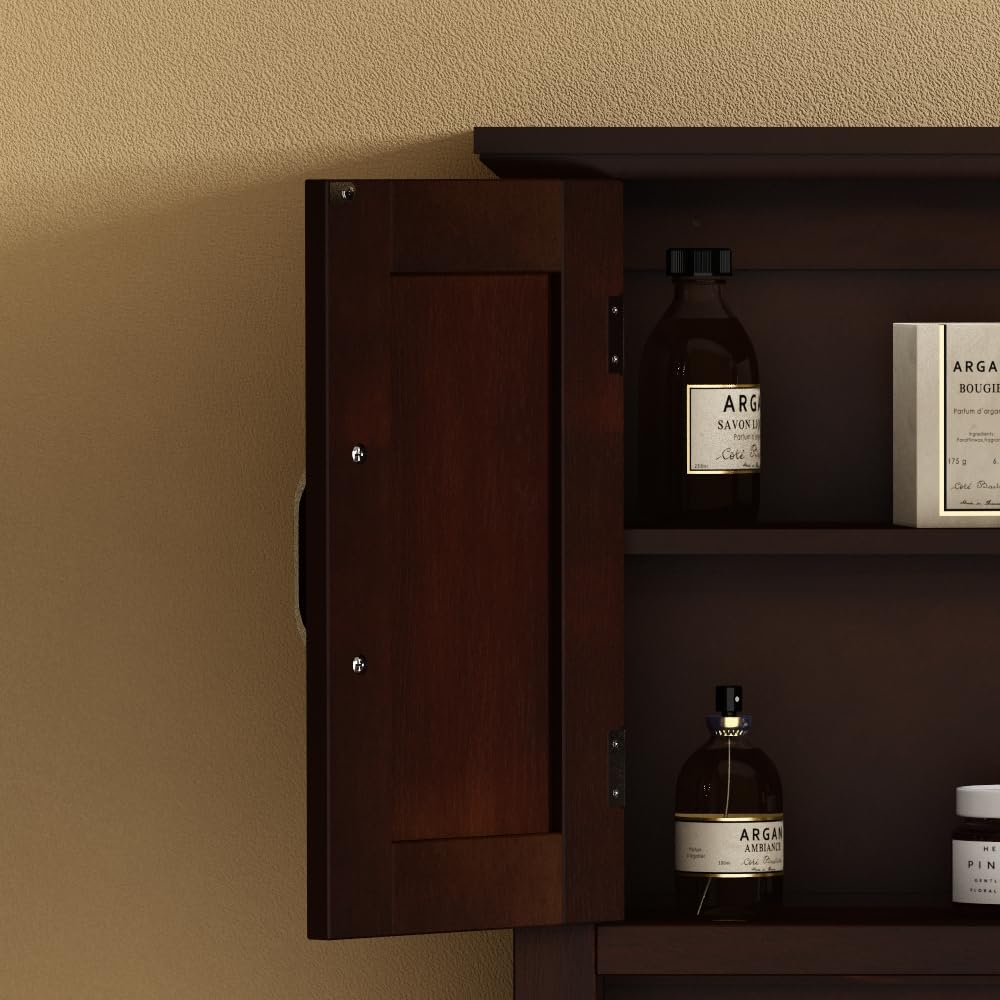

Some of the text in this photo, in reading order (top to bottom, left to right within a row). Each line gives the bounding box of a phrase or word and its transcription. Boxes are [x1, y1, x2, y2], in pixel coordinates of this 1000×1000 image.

[723, 394, 760, 413] ARG
[953, 407, 975, 415] Parfum
[717, 419, 751, 430] SAVON
[739, 827, 782, 841] ARGAN
